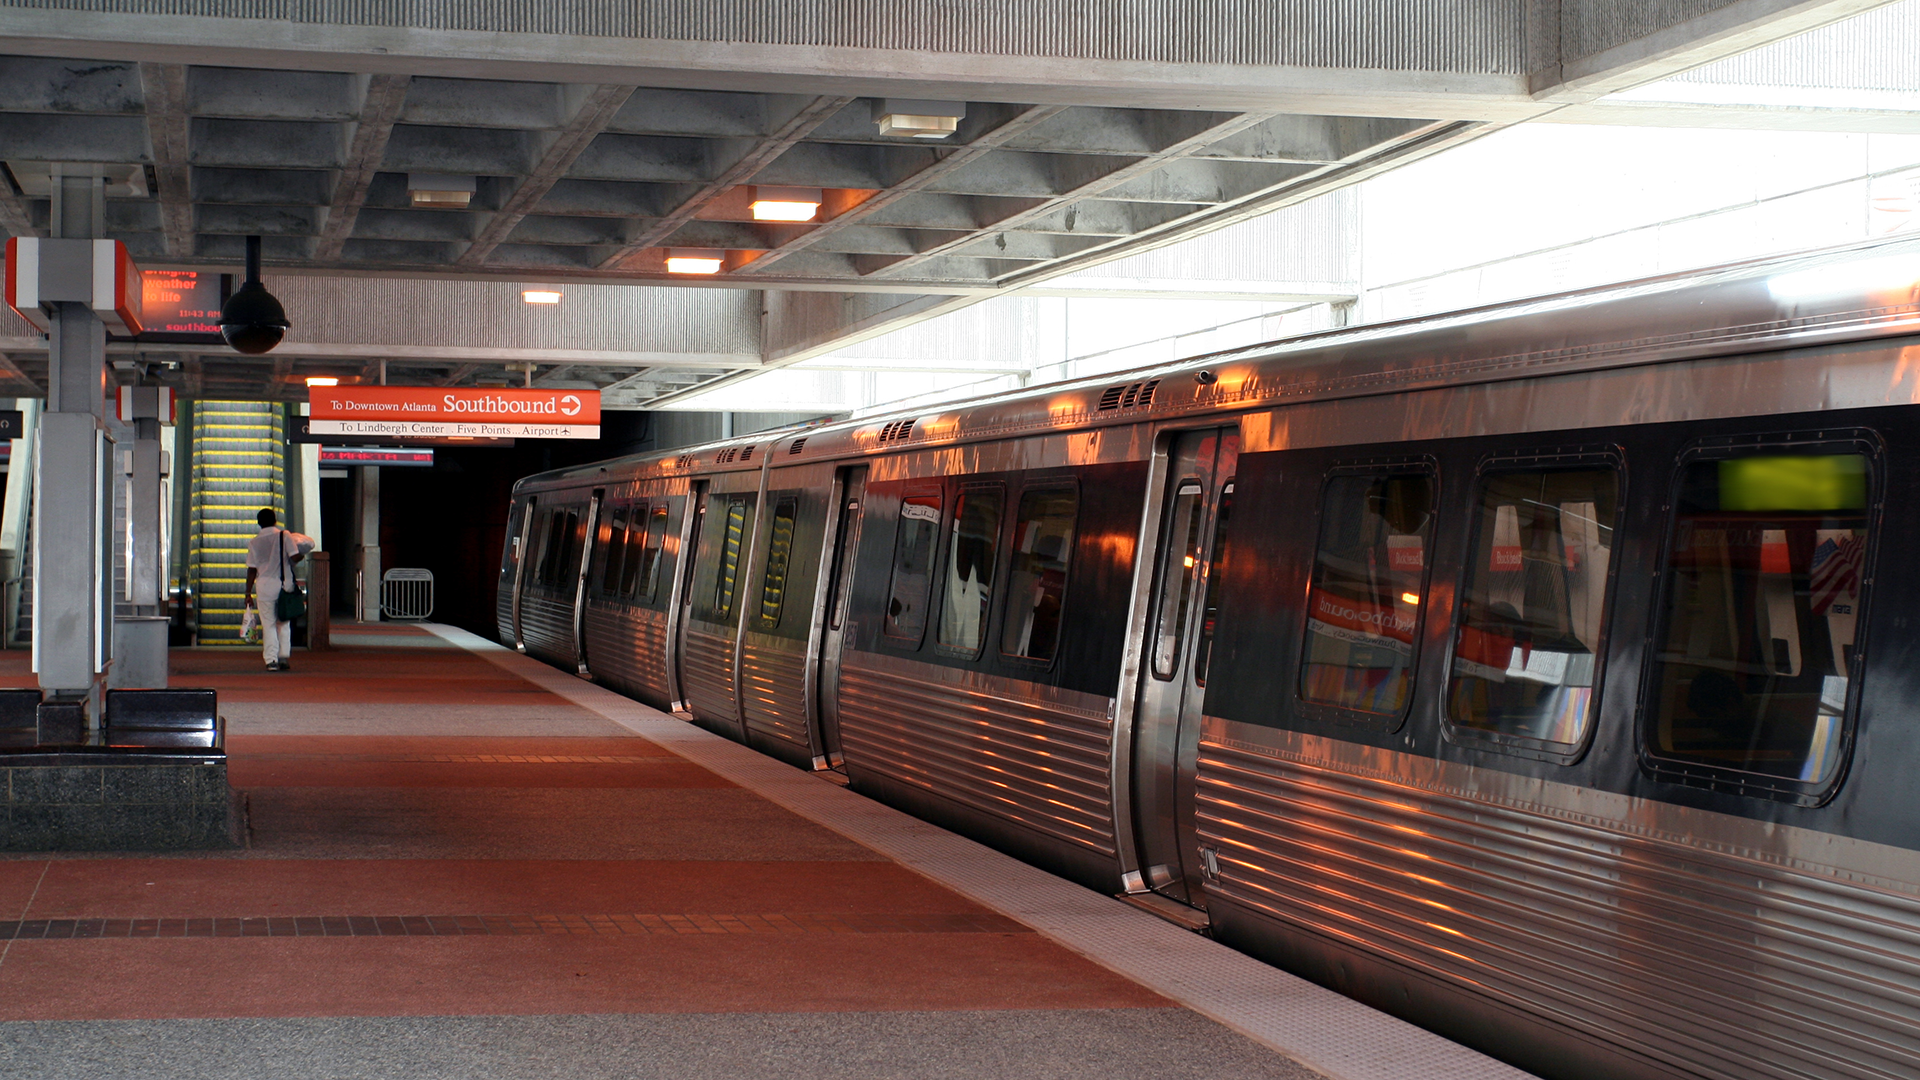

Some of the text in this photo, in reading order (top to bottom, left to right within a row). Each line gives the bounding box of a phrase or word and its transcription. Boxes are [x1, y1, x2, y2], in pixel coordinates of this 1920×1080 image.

[145, 279, 197, 289] weather
[145, 291, 181, 302] to life
[179, 309, 204, 318] 11:43
[330, 394, 557, 414] To Downtown Atlanta Southbound
[340, 422, 353, 432] To
[357, 422, 408, 434] Lindbergh
[411, 423, 445, 433] Center
[457, 424, 477, 434] Five
